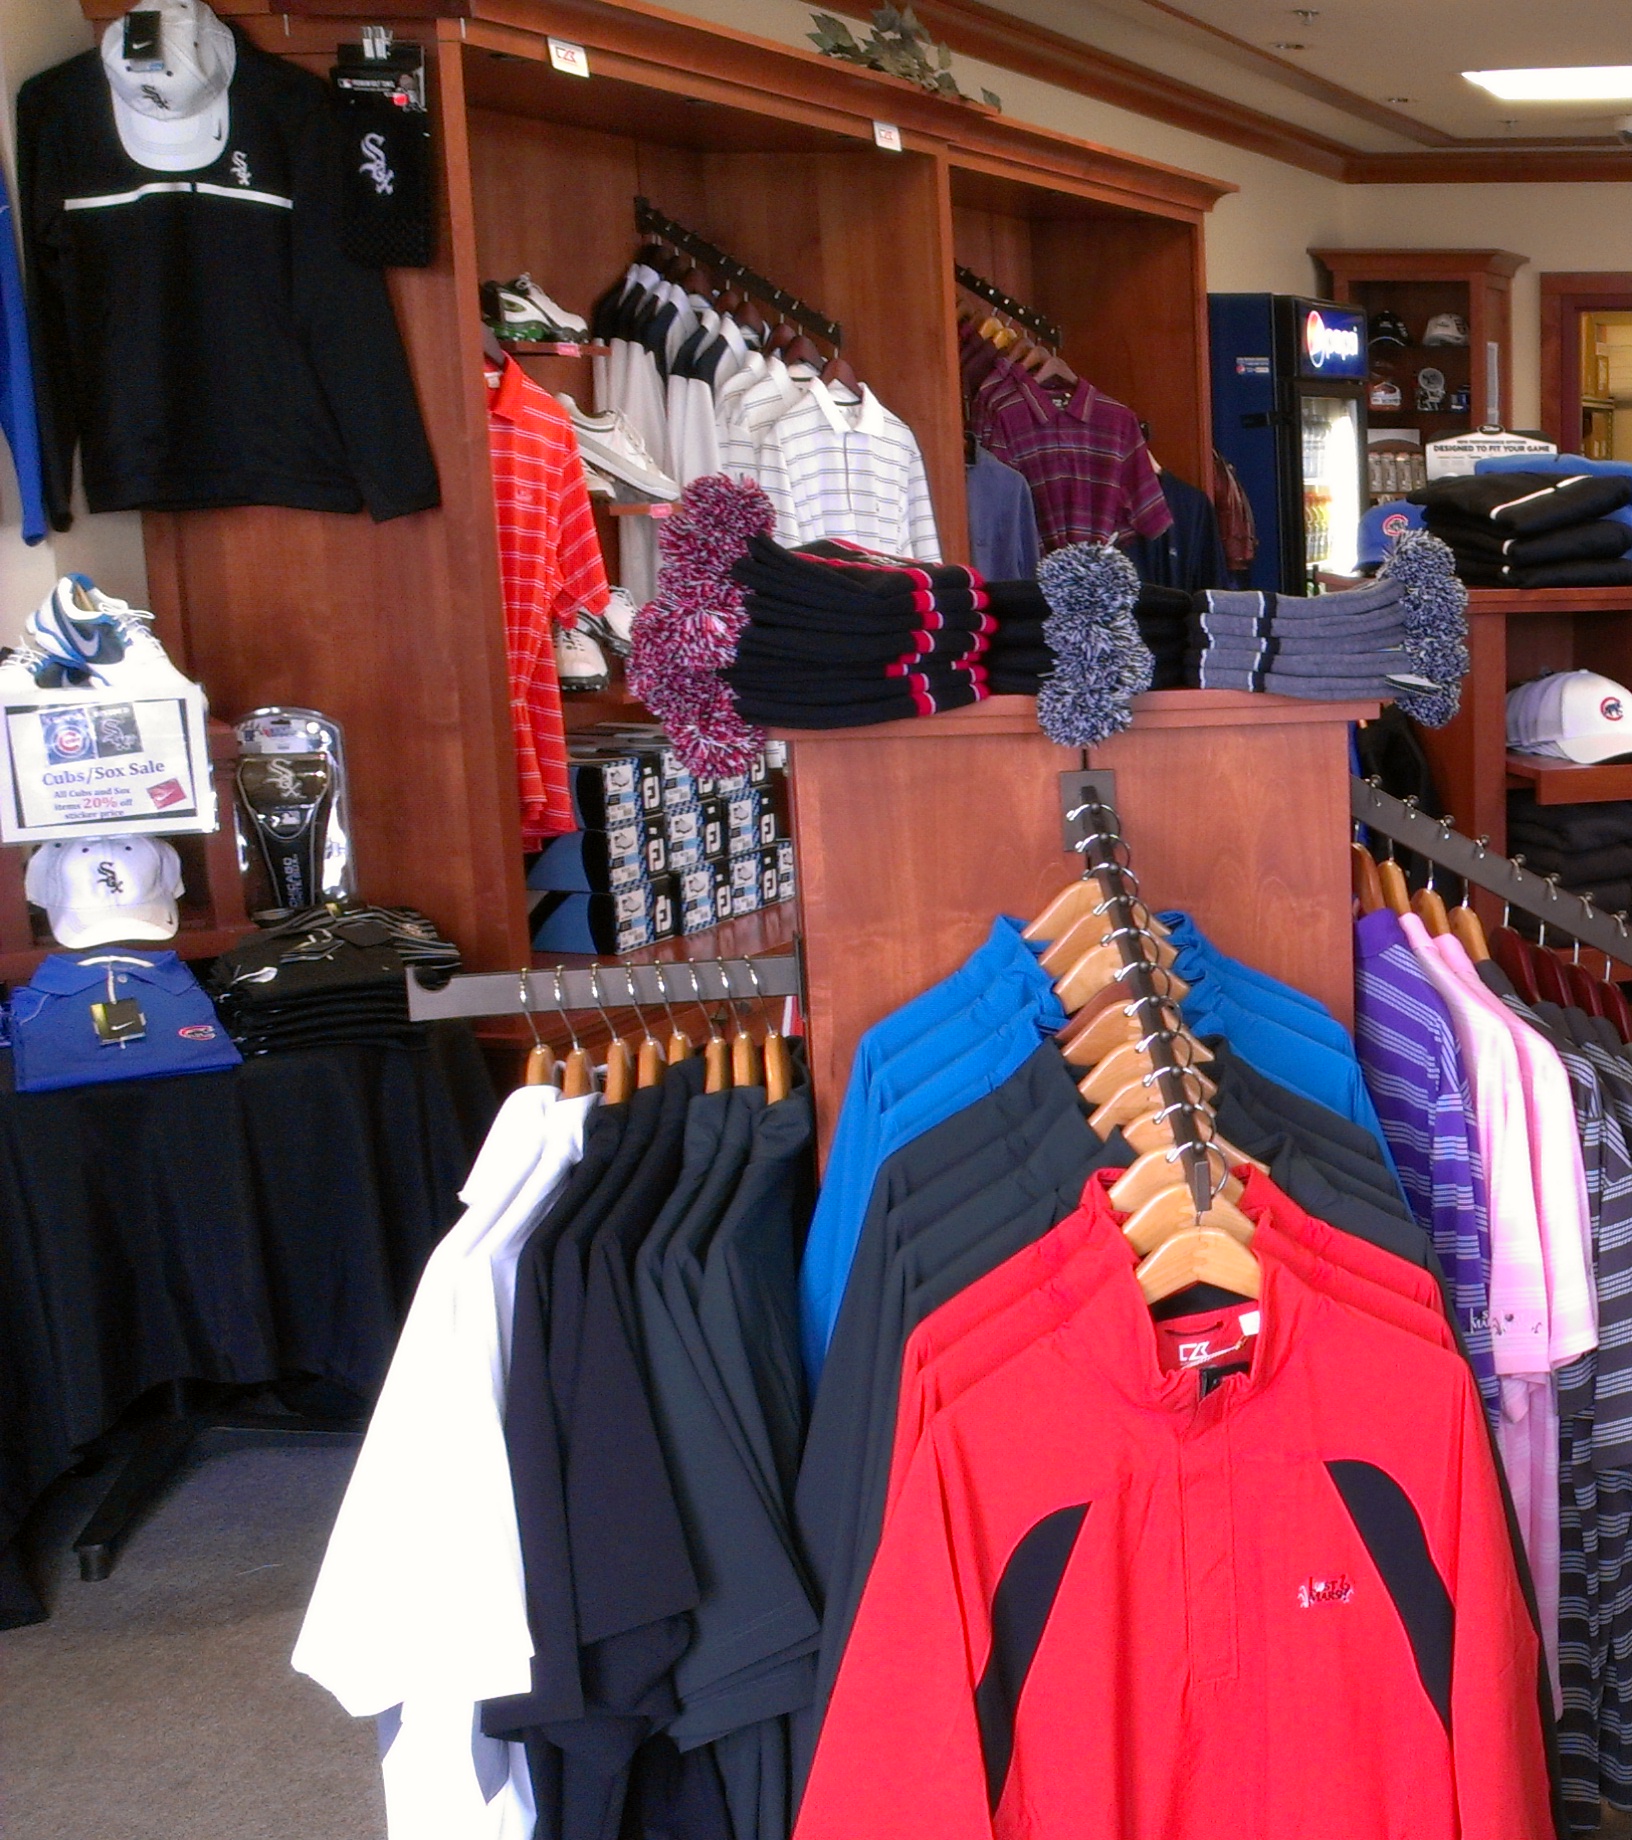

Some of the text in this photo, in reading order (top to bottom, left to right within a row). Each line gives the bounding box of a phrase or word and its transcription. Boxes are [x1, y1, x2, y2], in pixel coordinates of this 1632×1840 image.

[42, 760, 166, 787] Cubs/Sox Sale
[54, 787, 131, 799] All Cubs and Sox
[54, 797, 133, 811] items 20% off
[64, 810, 125, 820] sticker price
[97, 861, 124, 894] Sox
